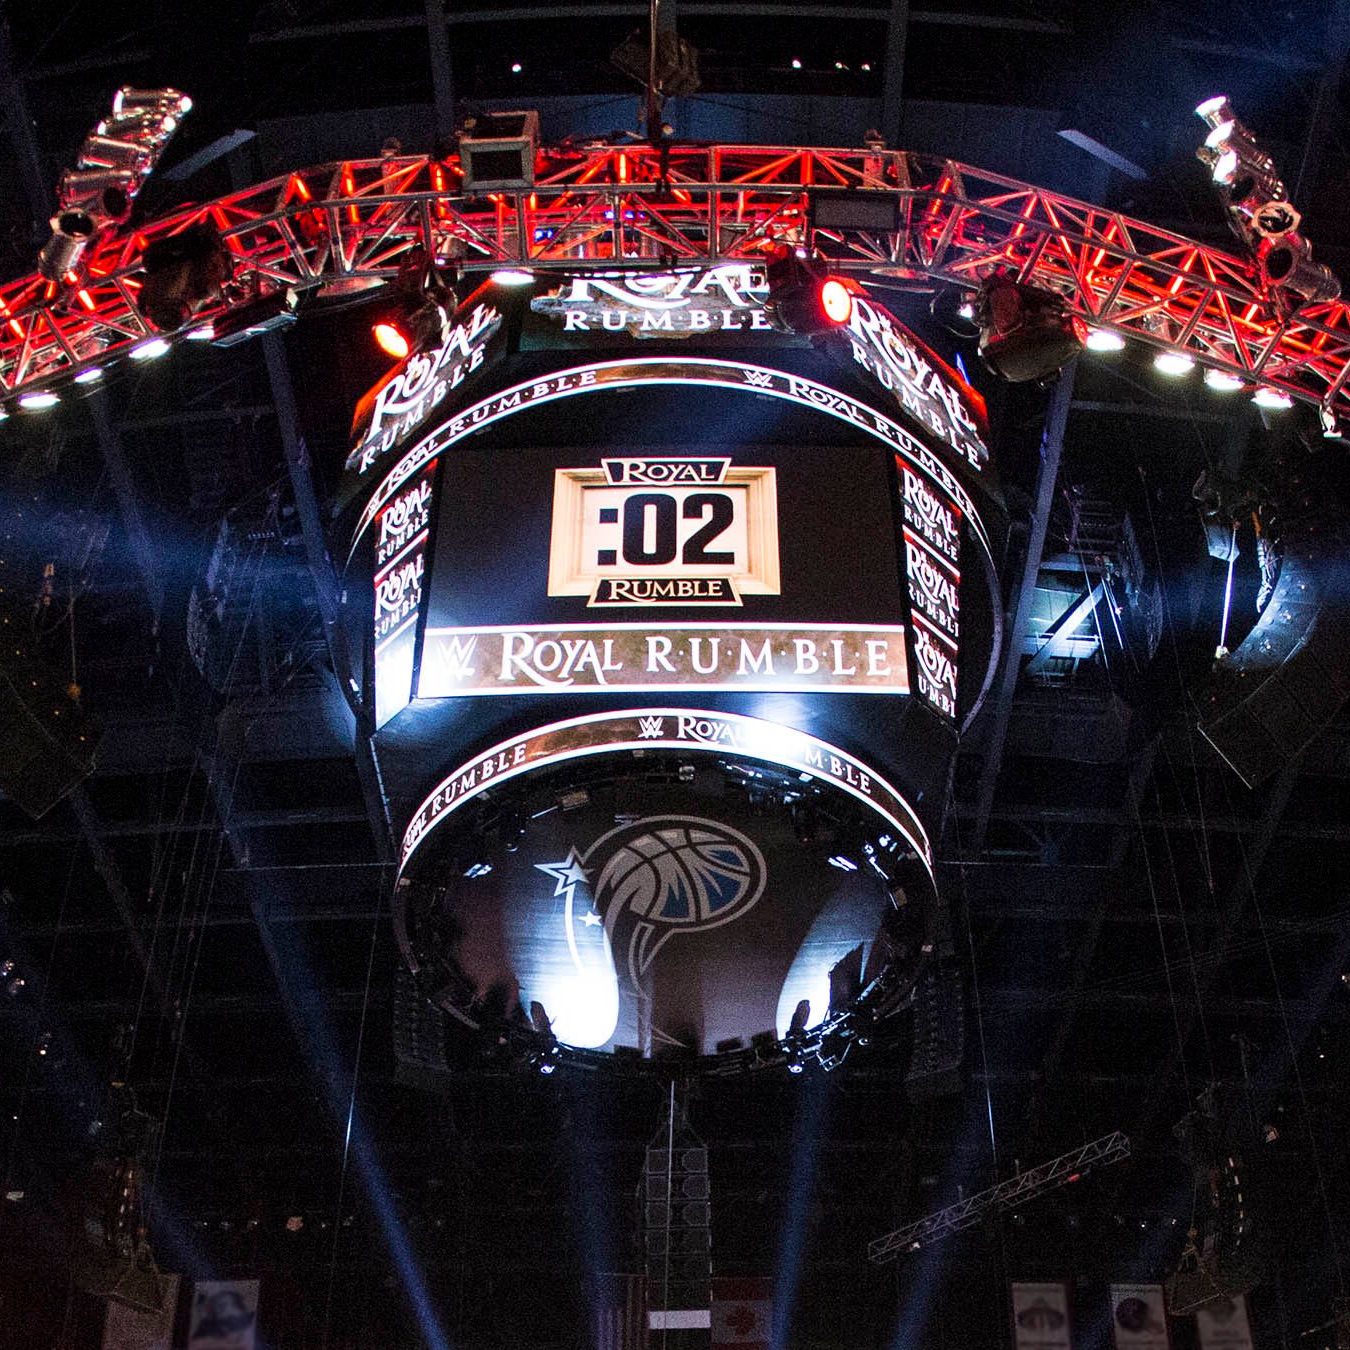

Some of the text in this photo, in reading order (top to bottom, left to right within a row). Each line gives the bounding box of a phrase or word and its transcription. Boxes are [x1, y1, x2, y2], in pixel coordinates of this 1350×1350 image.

[365, 303, 502, 444] ROYAL
[849, 297, 977, 436] ROYAL
[789, 379, 869, 423] ROYAL
[621, 461, 715, 486] ROYAL
[903, 467, 959, 542] ROYAL
[380, 480, 433, 547] ROYAL
[598, 493, 735, 566] :02
[374, 553, 425, 621] ROYAL
[608, 579, 723, 602] RUMBLE
[906, 541, 960, 618] ROYAL
[498, 632, 623, 687] ROYAL
